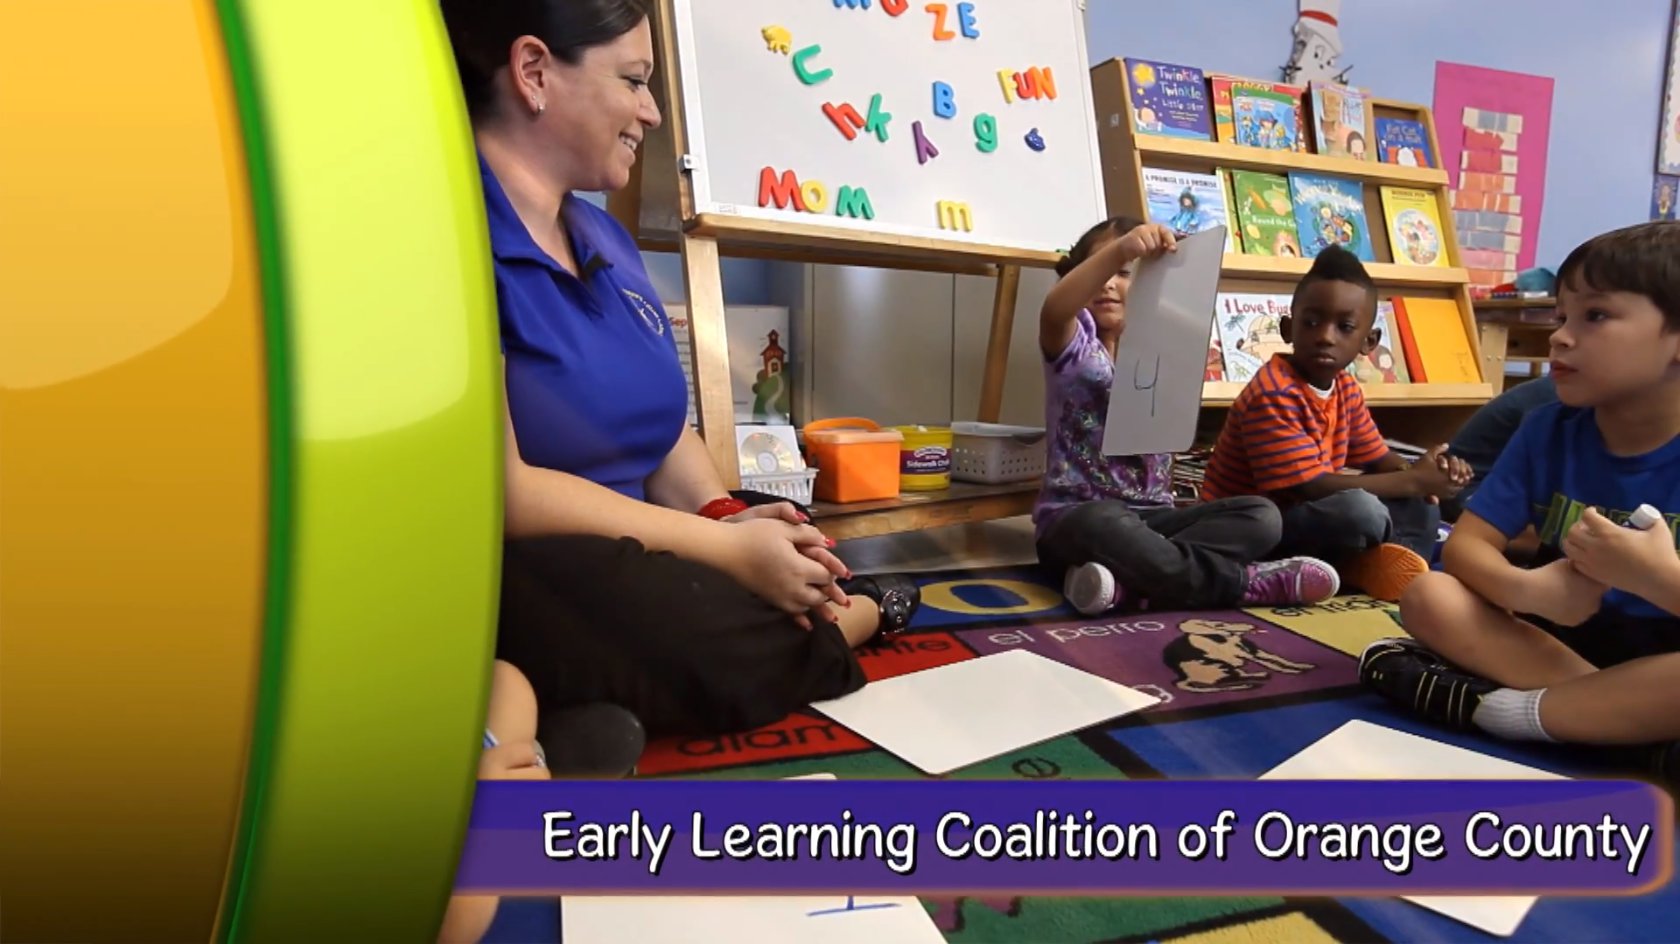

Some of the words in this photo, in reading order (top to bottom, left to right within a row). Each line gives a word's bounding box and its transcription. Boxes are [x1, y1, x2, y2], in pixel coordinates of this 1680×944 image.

[932, 80, 957, 119] B
[997, 66, 1057, 103] FUN
[973, 112, 998, 153] g
[1235, 299, 1264, 314] Love
[1047, 620, 1165, 645] perro
